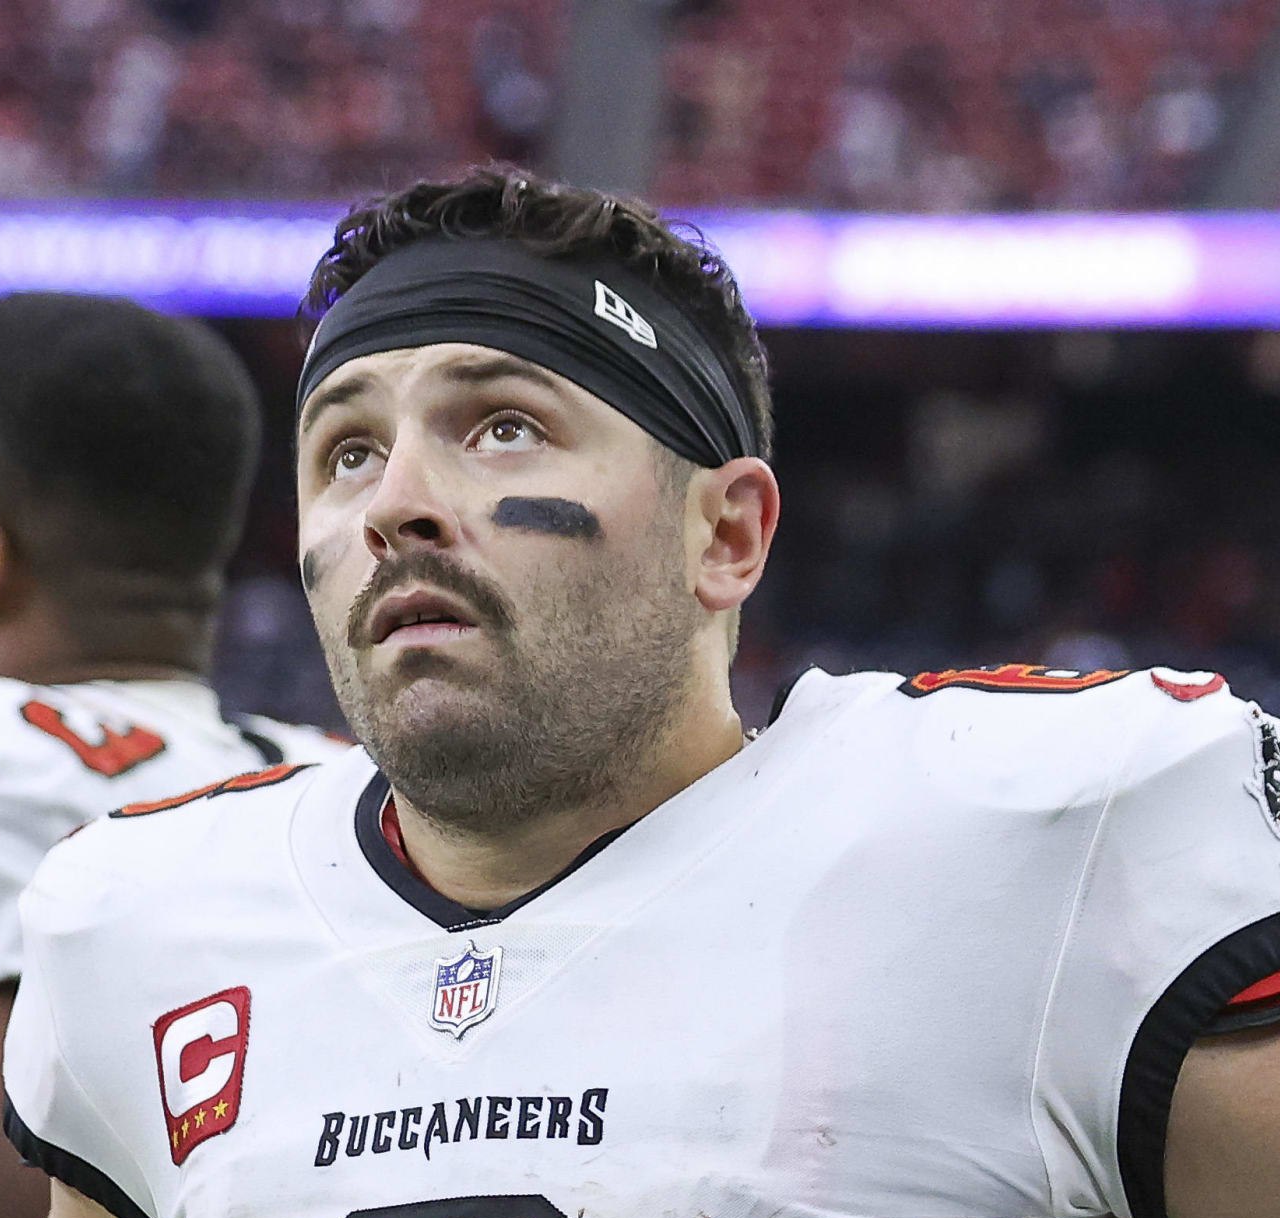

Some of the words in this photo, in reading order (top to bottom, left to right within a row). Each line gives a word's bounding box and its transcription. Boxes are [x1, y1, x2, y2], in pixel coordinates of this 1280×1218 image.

[438, 982, 484, 1018] NFL
[161, 1000, 239, 1118] C
[314, 1088, 609, 1167] BUCCANEERS
